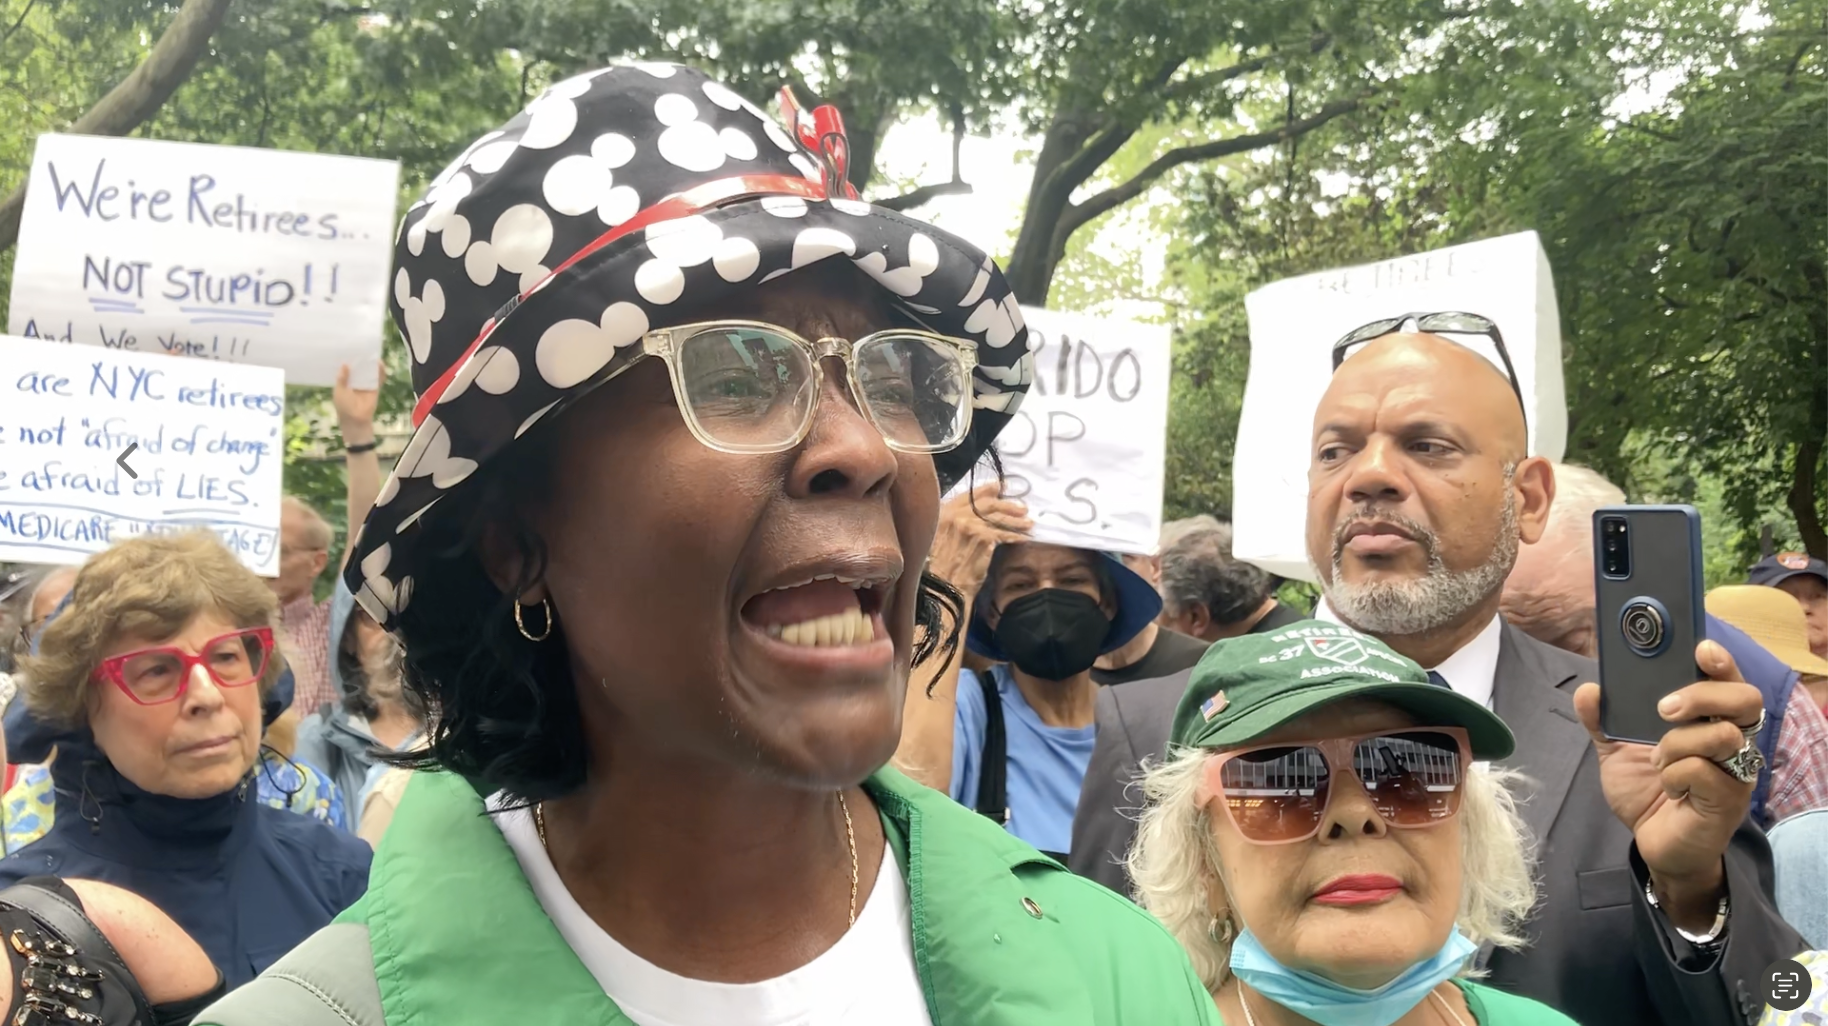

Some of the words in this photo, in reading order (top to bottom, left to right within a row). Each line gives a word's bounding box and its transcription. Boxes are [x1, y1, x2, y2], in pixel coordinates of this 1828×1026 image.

[48, 158, 174, 221] We're
[83, 254, 151, 298] NOT
[99, 324, 139, 351] We
[16, 370, 73, 397] are
[90, 361, 165, 401] NYC
[178, 378, 283, 416] retirees
[20, 416, 65, 446] not
[171, 424, 208, 455] of
[21, 461, 120, 496] afraid
[133, 468, 165, 497] of
[1270, 627, 1378, 645] RETIRE
[1278, 644, 1306, 661] 37
[1300, 665, 1400, 683] ASSOCIATION
